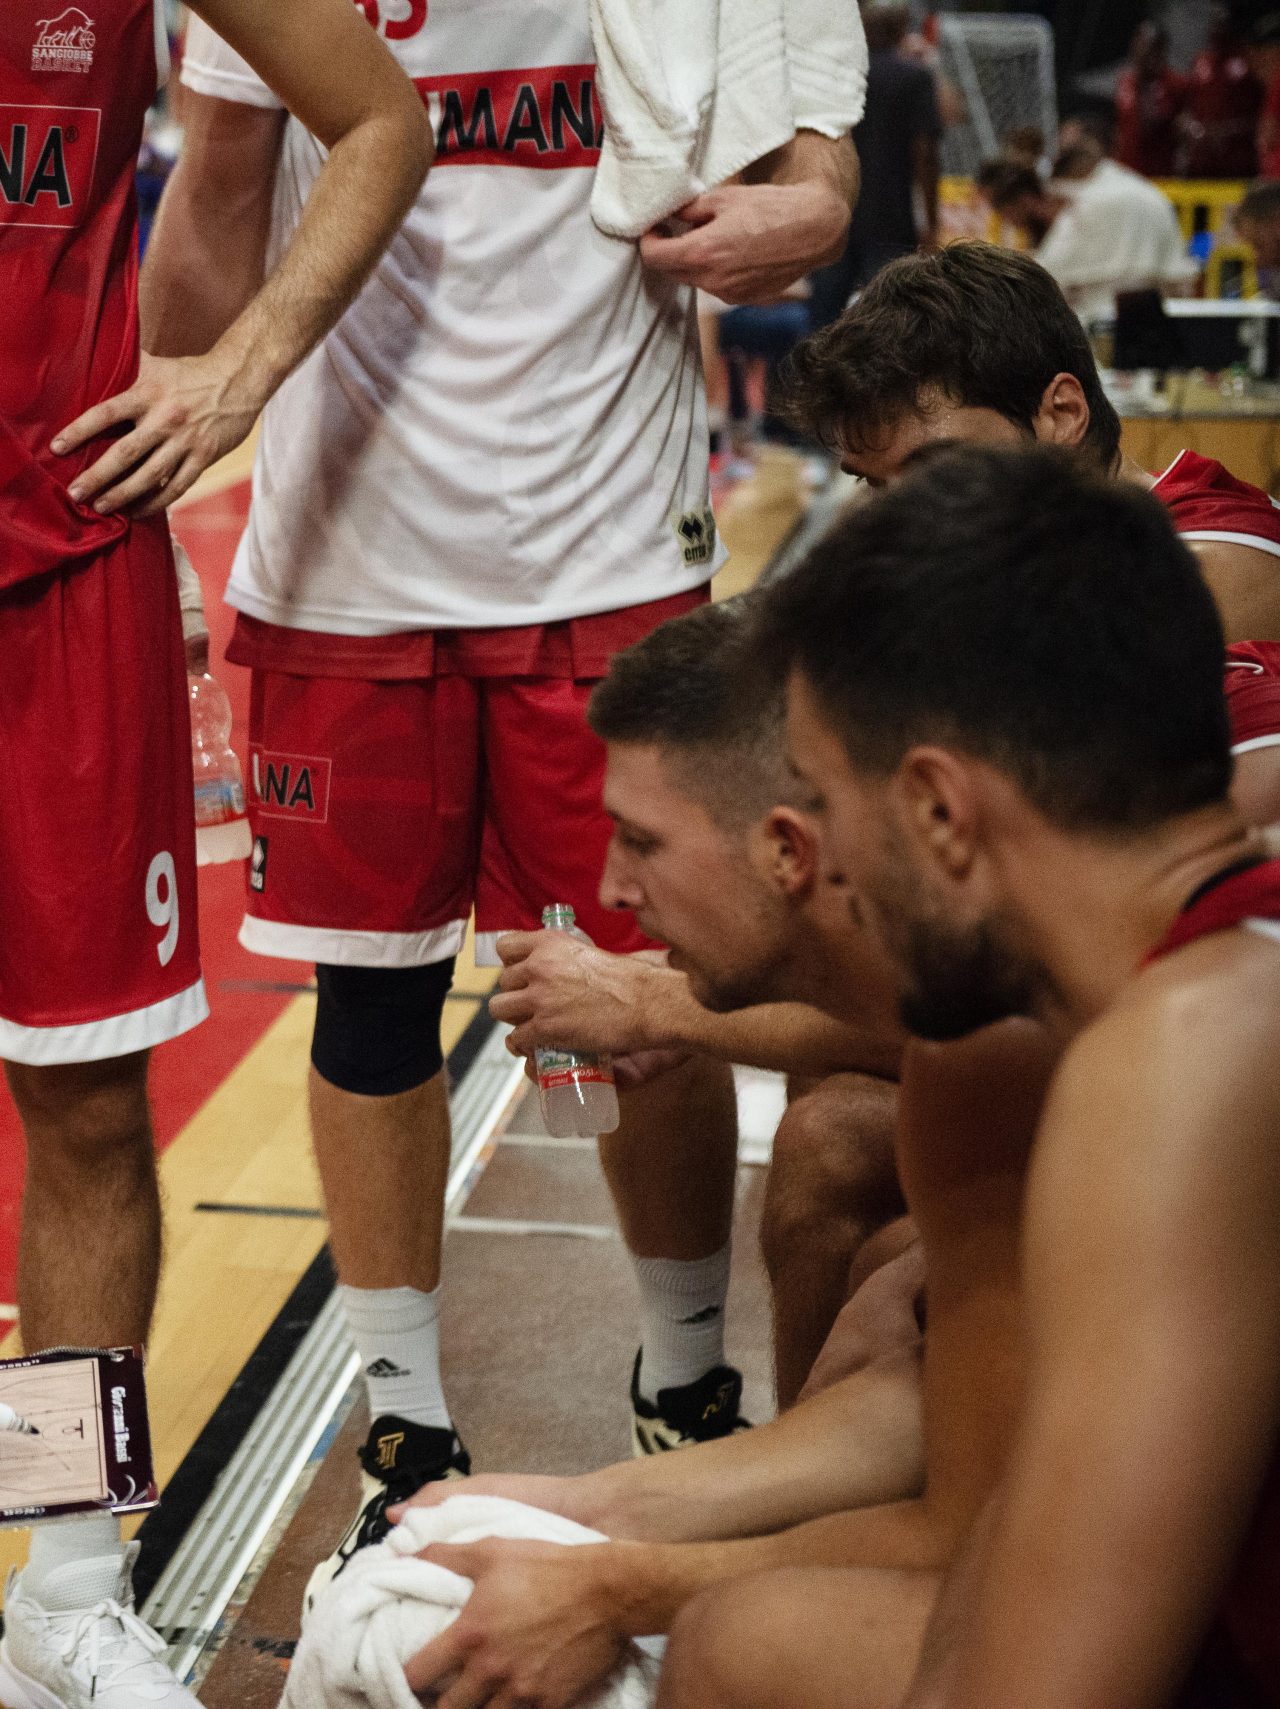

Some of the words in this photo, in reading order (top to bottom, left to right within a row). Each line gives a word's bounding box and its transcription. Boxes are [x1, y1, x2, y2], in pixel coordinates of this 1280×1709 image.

[31, 47, 94, 61] SANGIOBBE
[31, 57, 92, 73] BASKET
[426, 78, 606, 155] MAN
[145, 850, 180, 968] 9
